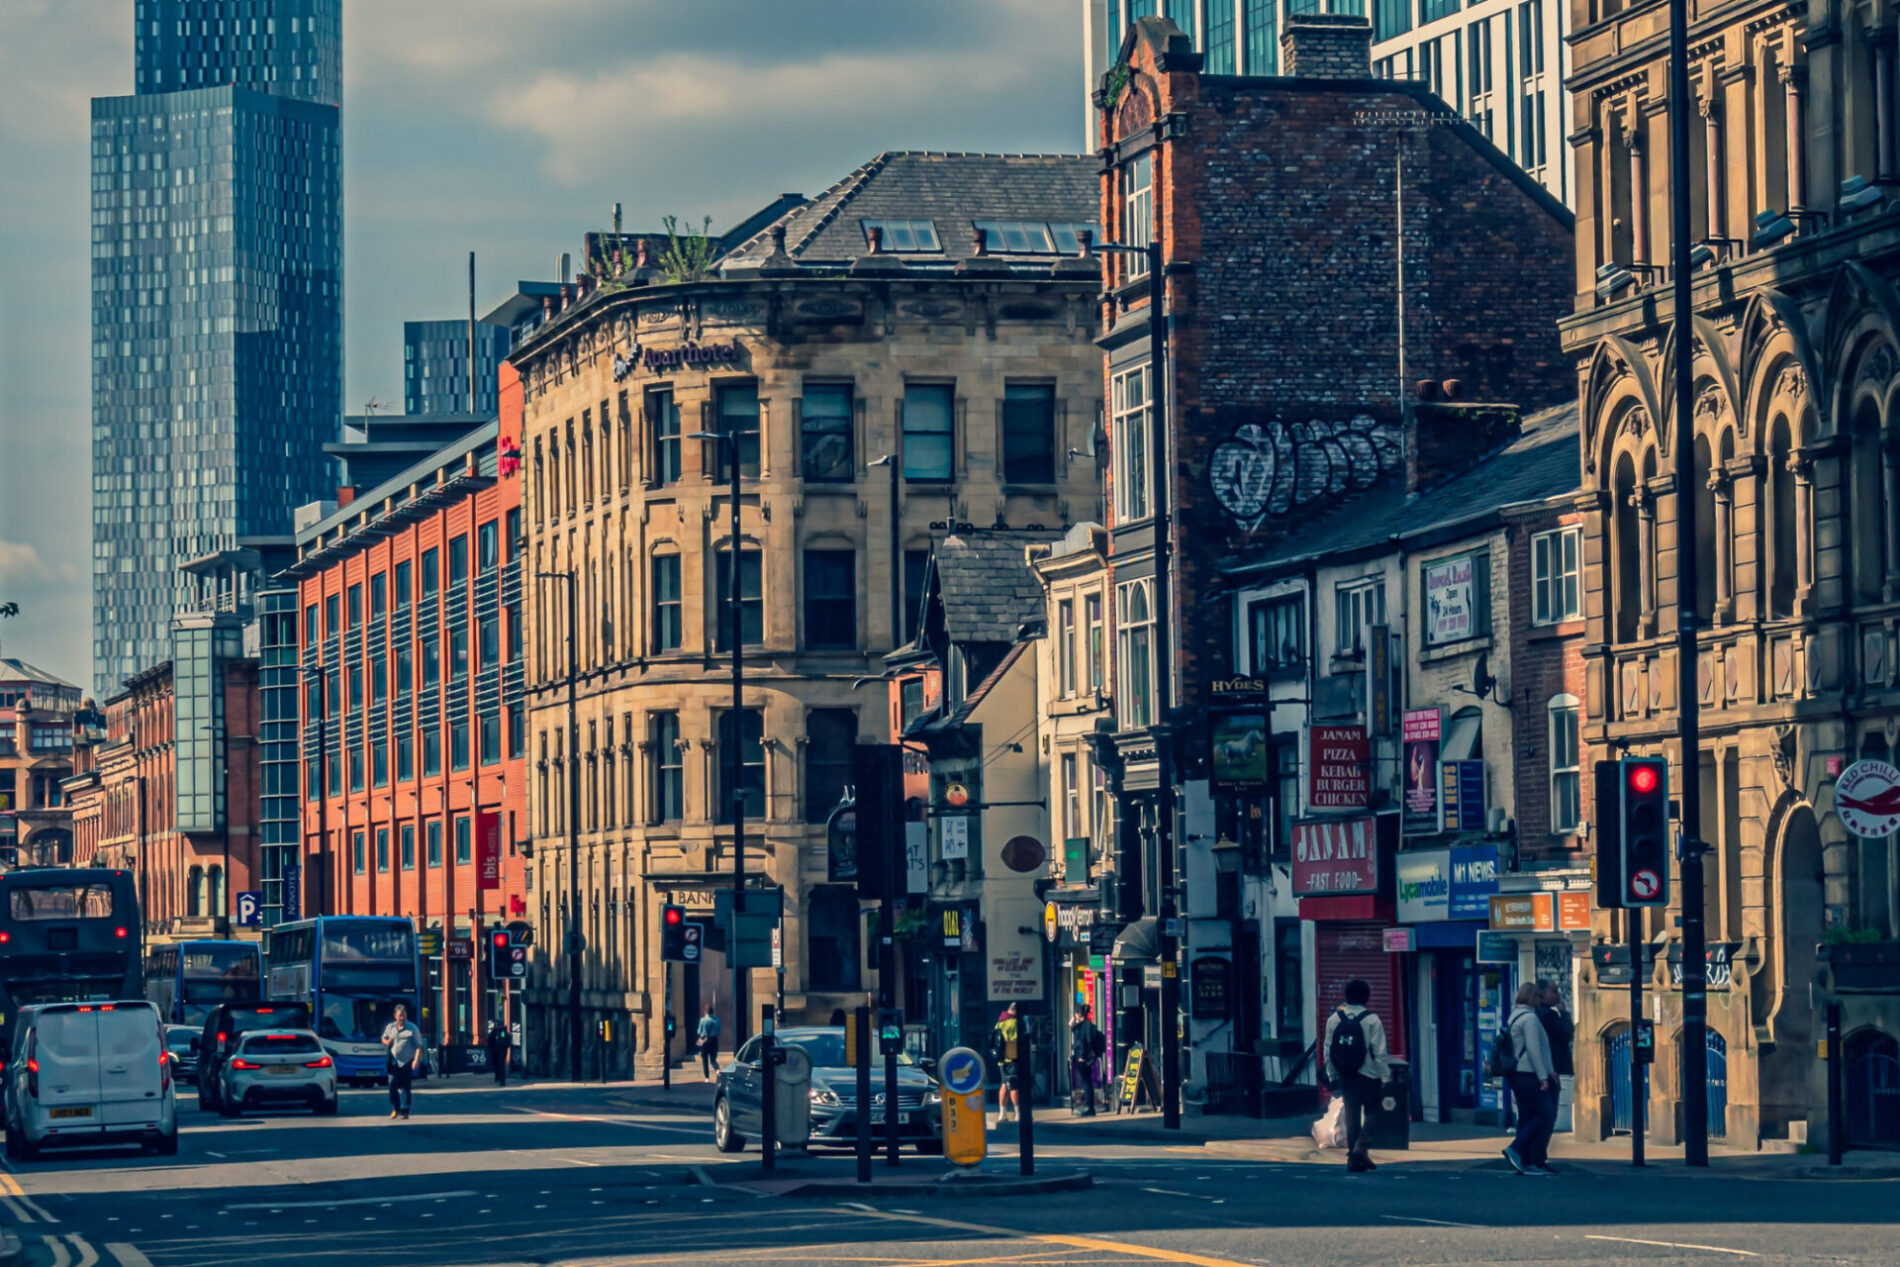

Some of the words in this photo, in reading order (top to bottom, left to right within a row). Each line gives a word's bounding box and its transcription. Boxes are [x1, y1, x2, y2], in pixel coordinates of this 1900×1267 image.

[643, 338, 738, 372] Aparthotel
[1211, 677, 1265, 692] HYDES
[1320, 730, 1361, 740] JANAM
[1323, 748, 1356, 760] PIZZA
[1321, 765, 1361, 777] KEBAB
[1841, 768, 1858, 791] RED
[1860, 762, 1900, 782] CHILLI
[1316, 779, 1365, 791] BURGER
[1314, 793, 1367, 804] CHICKEN
[1297, 822, 1365, 862] JANAM
[1454, 863, 1466, 883] M1
[1468, 860, 1495, 883] NEWS
[288, 871, 297, 915] NOVOTEL
[240, 900, 255, 923] P
[943, 910, 960, 936] 0161
[454, 947, 468, 955] 96
[472, 1054, 486, 1063] 96
